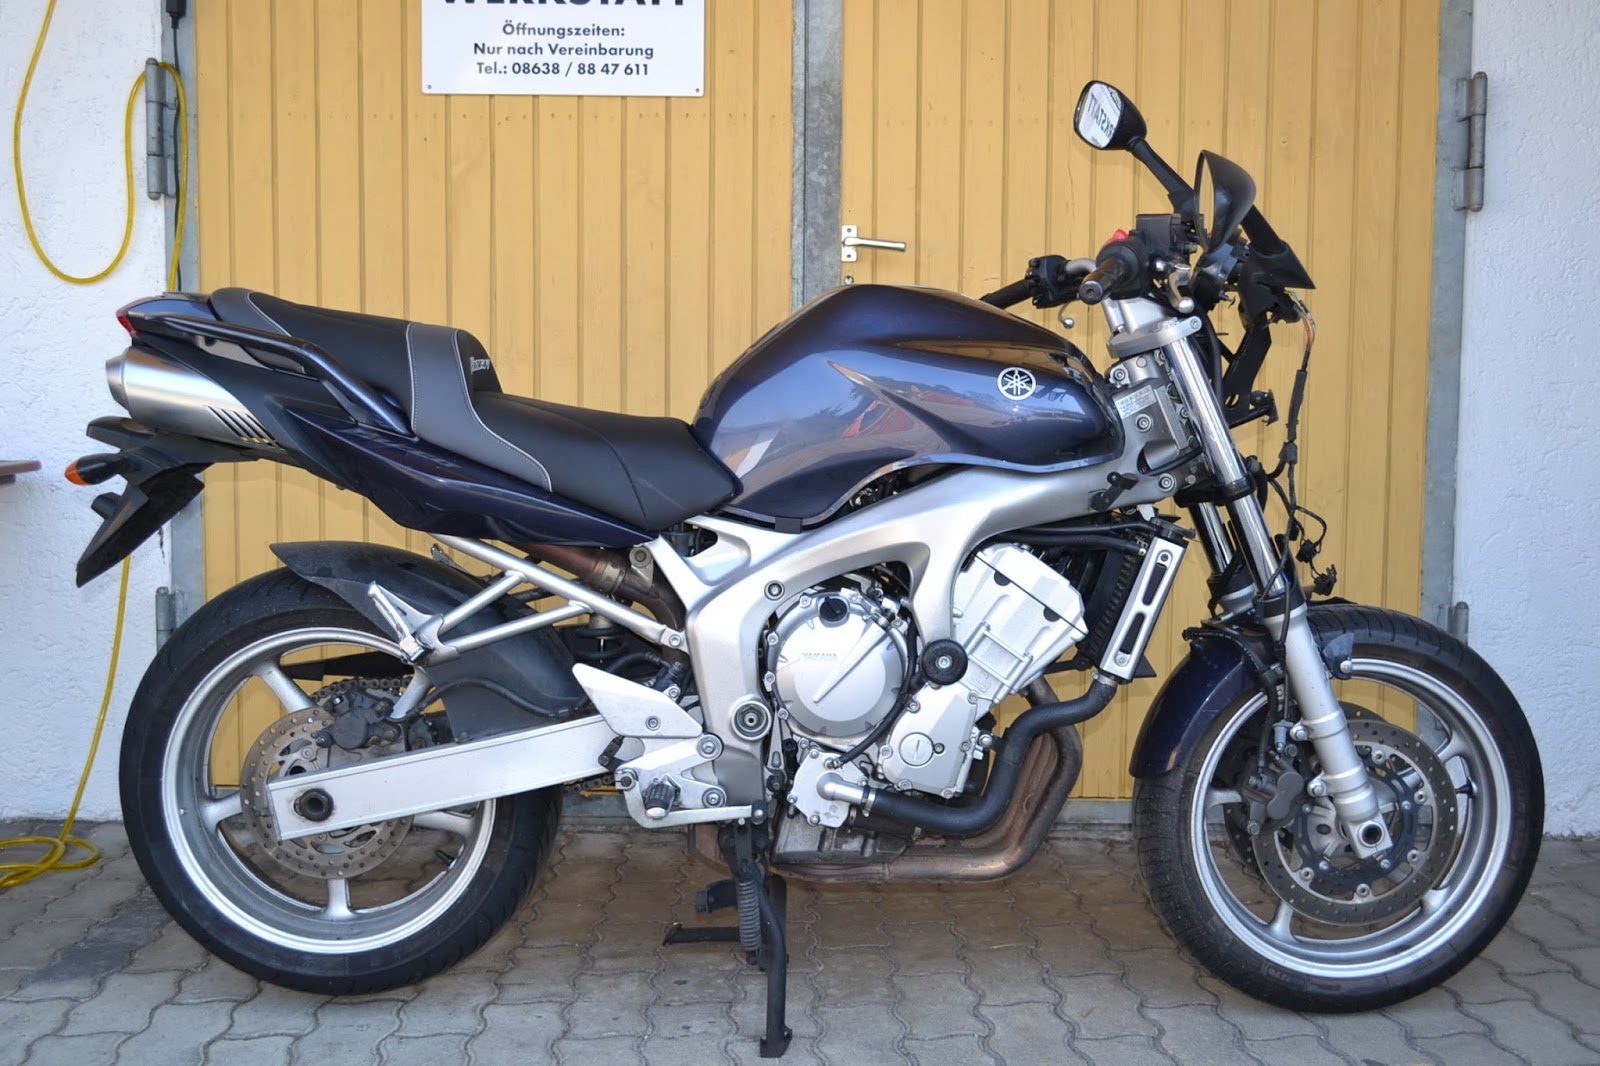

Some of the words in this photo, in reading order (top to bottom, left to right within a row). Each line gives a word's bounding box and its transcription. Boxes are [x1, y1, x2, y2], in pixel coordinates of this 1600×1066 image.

[502, 19, 625, 39] Öffnungszeiten:
[473, 42, 503, 55] Nur
[507, 42, 543, 56] nach
[548, 43, 654, 60] Vereinbarung
[476, 61, 507, 75] Tel.:
[511, 62, 561, 75] 08638
[564, 62, 573, 77] /
[577, 63, 597, 76] 88
[600, 63, 620, 76] 47
[624, 63, 648, 76] 611
